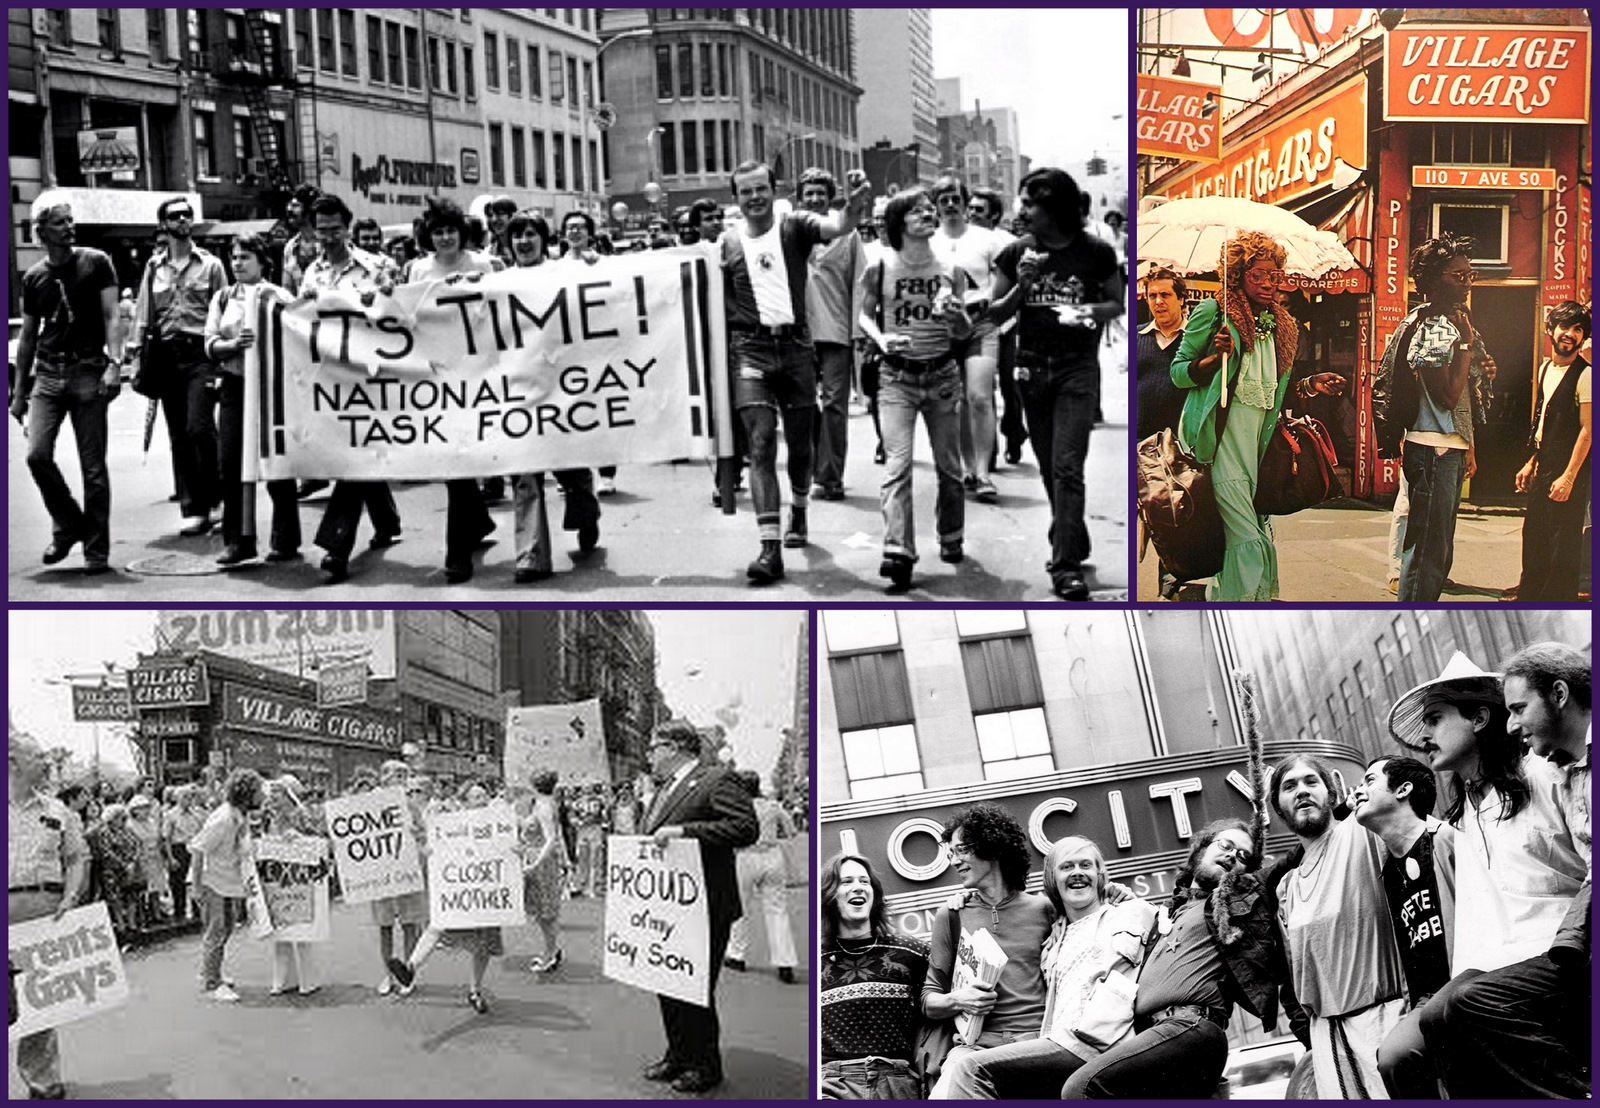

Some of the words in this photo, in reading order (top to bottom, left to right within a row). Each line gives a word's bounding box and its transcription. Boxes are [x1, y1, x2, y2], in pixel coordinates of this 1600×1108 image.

[1402, 36, 1576, 69] VILLAGE
[1407, 73, 1557, 114] CIGARS
[1230, 117, 1336, 199] CIGARS
[1426, 170, 1448, 185] 110
[1387, 200, 1401, 295] PIPES
[1553, 175, 1568, 281] CLOCKS
[1287, 278, 1359, 289] CIGARETTES
[1378, 305, 1403, 313] COPIES
[310, 310, 413, 364] IT'S
[313, 375, 526, 411] NATIONAL
[560, 359, 657, 395] GAY
[338, 415, 447, 447] TASK
[478, 396, 635, 441] FORCE
[1358, 326, 1368, 494] STATIONERY
[237, 696, 323, 731] VILLAGE
[327, 716, 397, 748] CIGARS
[331, 806, 402, 838] COME
[347, 832, 403, 862] OUT!
[442, 859, 504, 883] CLOSET
[610, 865, 699, 906] PROUD
[440, 887, 513, 913] MOTHER
[1401, 889, 1431, 928] PETE
[647, 943, 694, 977] Son
